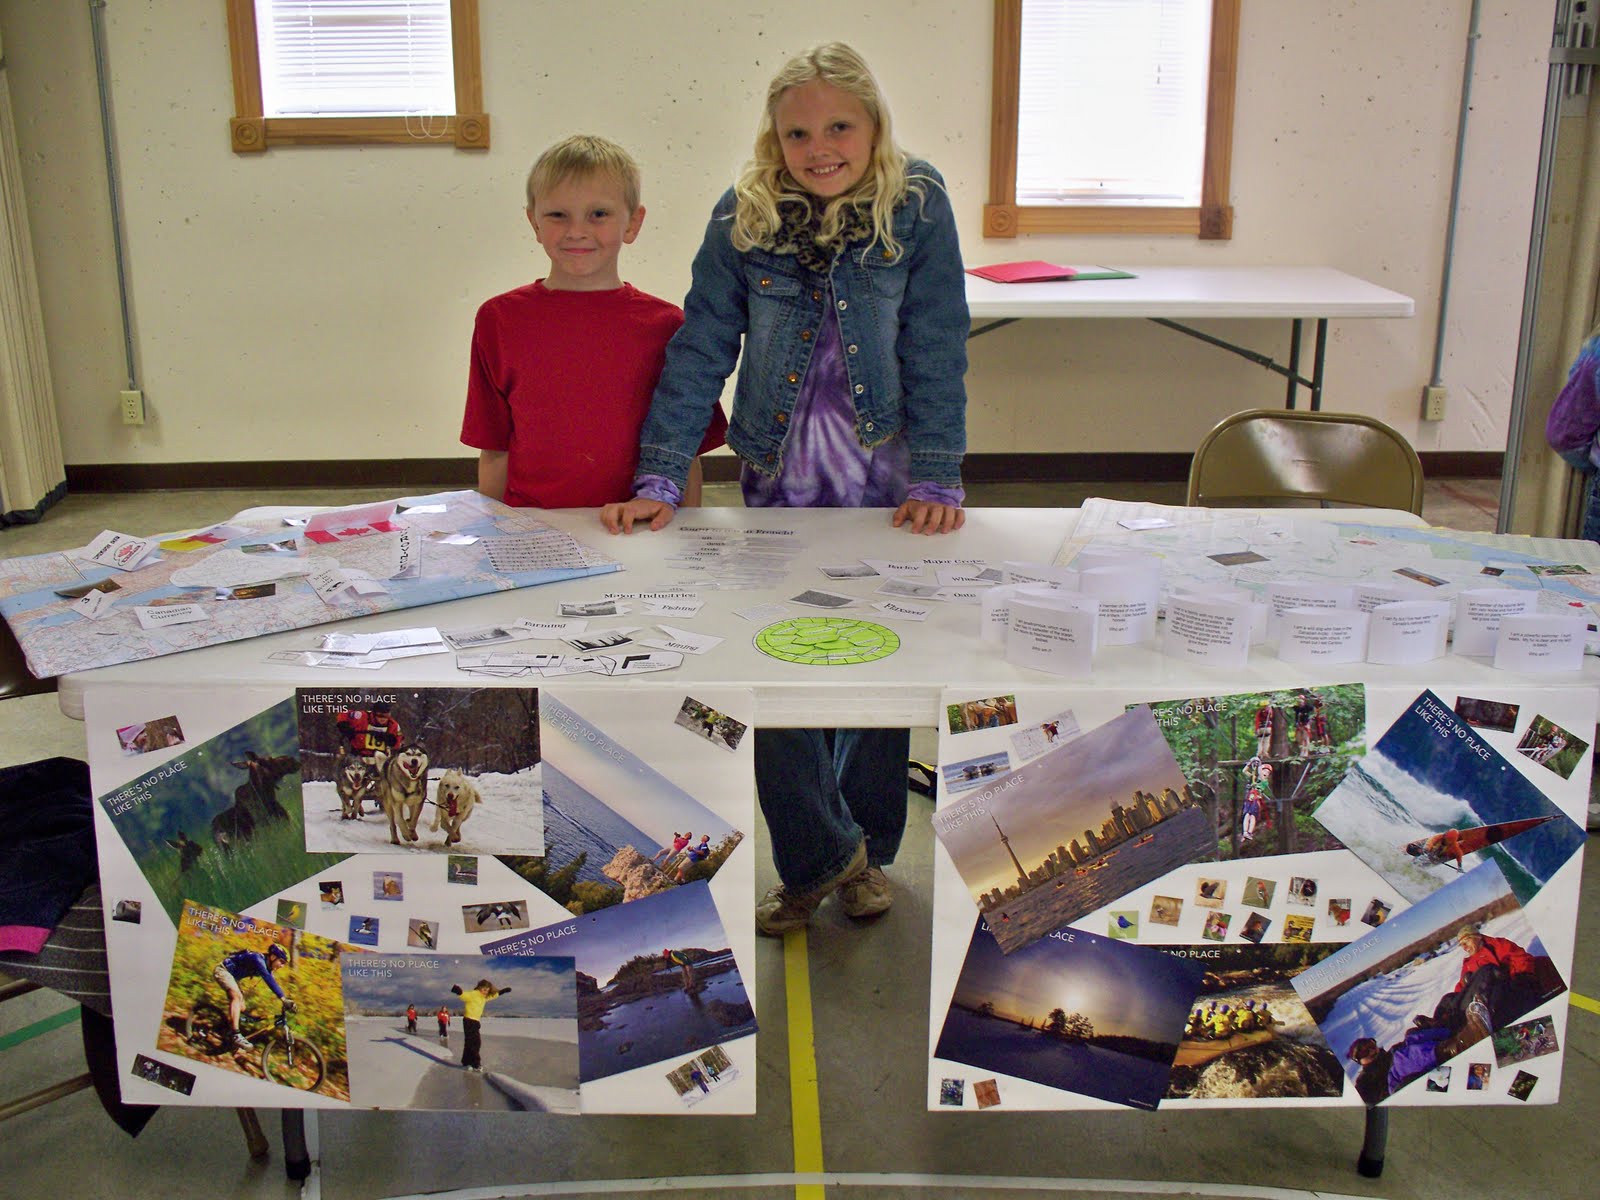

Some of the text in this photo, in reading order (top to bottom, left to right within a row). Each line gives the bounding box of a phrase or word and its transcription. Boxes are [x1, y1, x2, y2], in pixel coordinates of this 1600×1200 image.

[147, 606, 192, 615] Canadian
[150, 610, 193, 620] Currency
[662, 604, 698, 612] Fishing
[525, 621, 567, 630] Farming
[665, 641, 700, 652] Mining
[302, 694, 397, 703] THERE'S NO PLACE
[303, 705, 349, 713] LIKE THIS
[1152, 703, 1229, 717] RE'S NO PLACE
[1157, 717, 1179, 727] THIS
[1414, 705, 1451, 738] LIKE THIS
[1423, 697, 1491, 761] THERE'S NO PLACE
[545, 703, 626, 763] THERE'S NO PLACE
[560, 723, 579, 743] THIS
[107, 760, 188, 806] THERE'S NO PLACE
[112, 790, 152, 816] LIKE THIS
[938, 774, 1025, 824] THERE'S NO PLACE
[942, 807, 985, 833] LIKE THIS
[187, 918, 231, 936] LIKE THIS
[189, 907, 279, 939] THERE'S NO PLACE
[488, 924, 578, 956] THERE'S NO PLACE
[1170, 950, 1221, 958] NO PLACE
[1336, 953, 1352, 965] NO
[1352, 936, 1382, 957] PLACE
[348, 959, 439, 969] THERE'S NO PLACE
[348, 968, 392, 978] LIKE THIS
[1304, 969, 1345, 995] LIKE THIS
